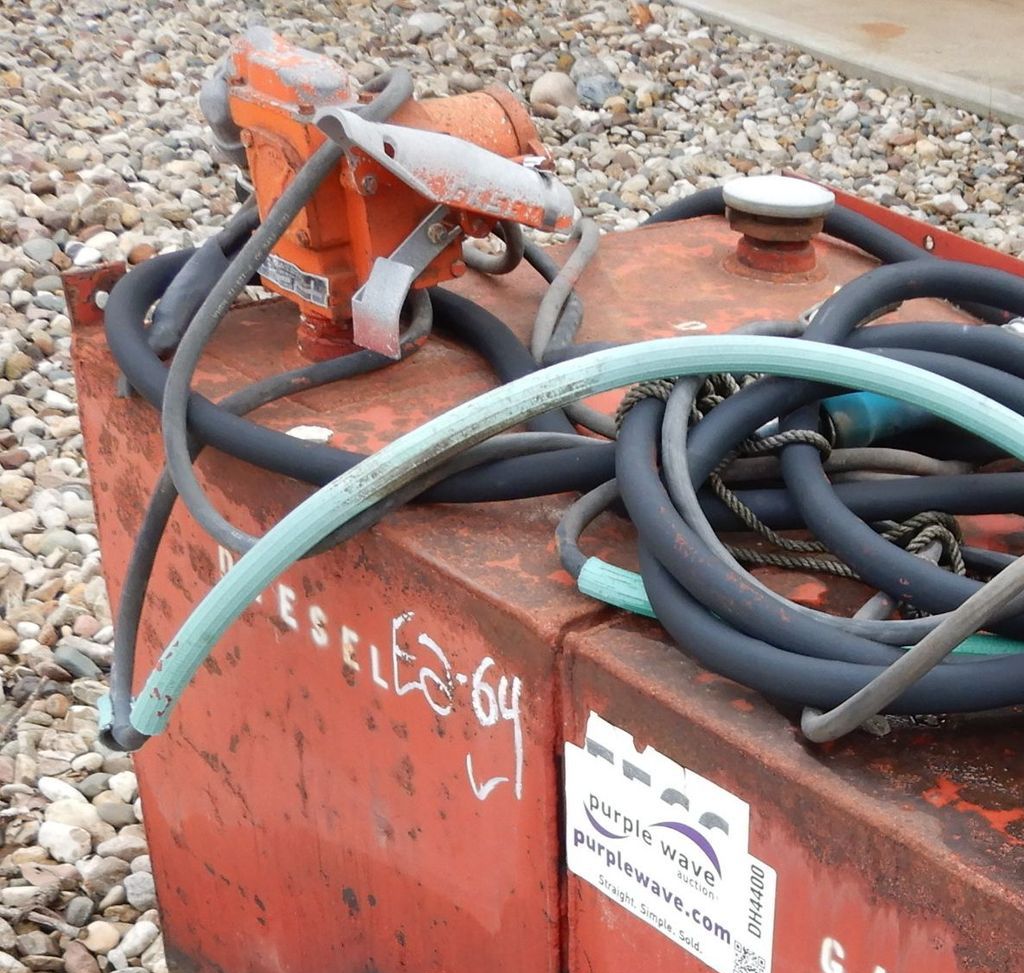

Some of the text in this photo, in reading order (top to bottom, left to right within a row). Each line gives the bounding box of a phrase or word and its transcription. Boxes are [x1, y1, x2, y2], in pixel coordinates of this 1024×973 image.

[217, 544, 389, 690] DESEL
[573, 827, 731, 945] purplewave.com
[589, 792, 716, 888] purple wave
[598, 874, 703, 954] Straight. Simple. Sold.
[747, 864, 765, 938] DH4400
